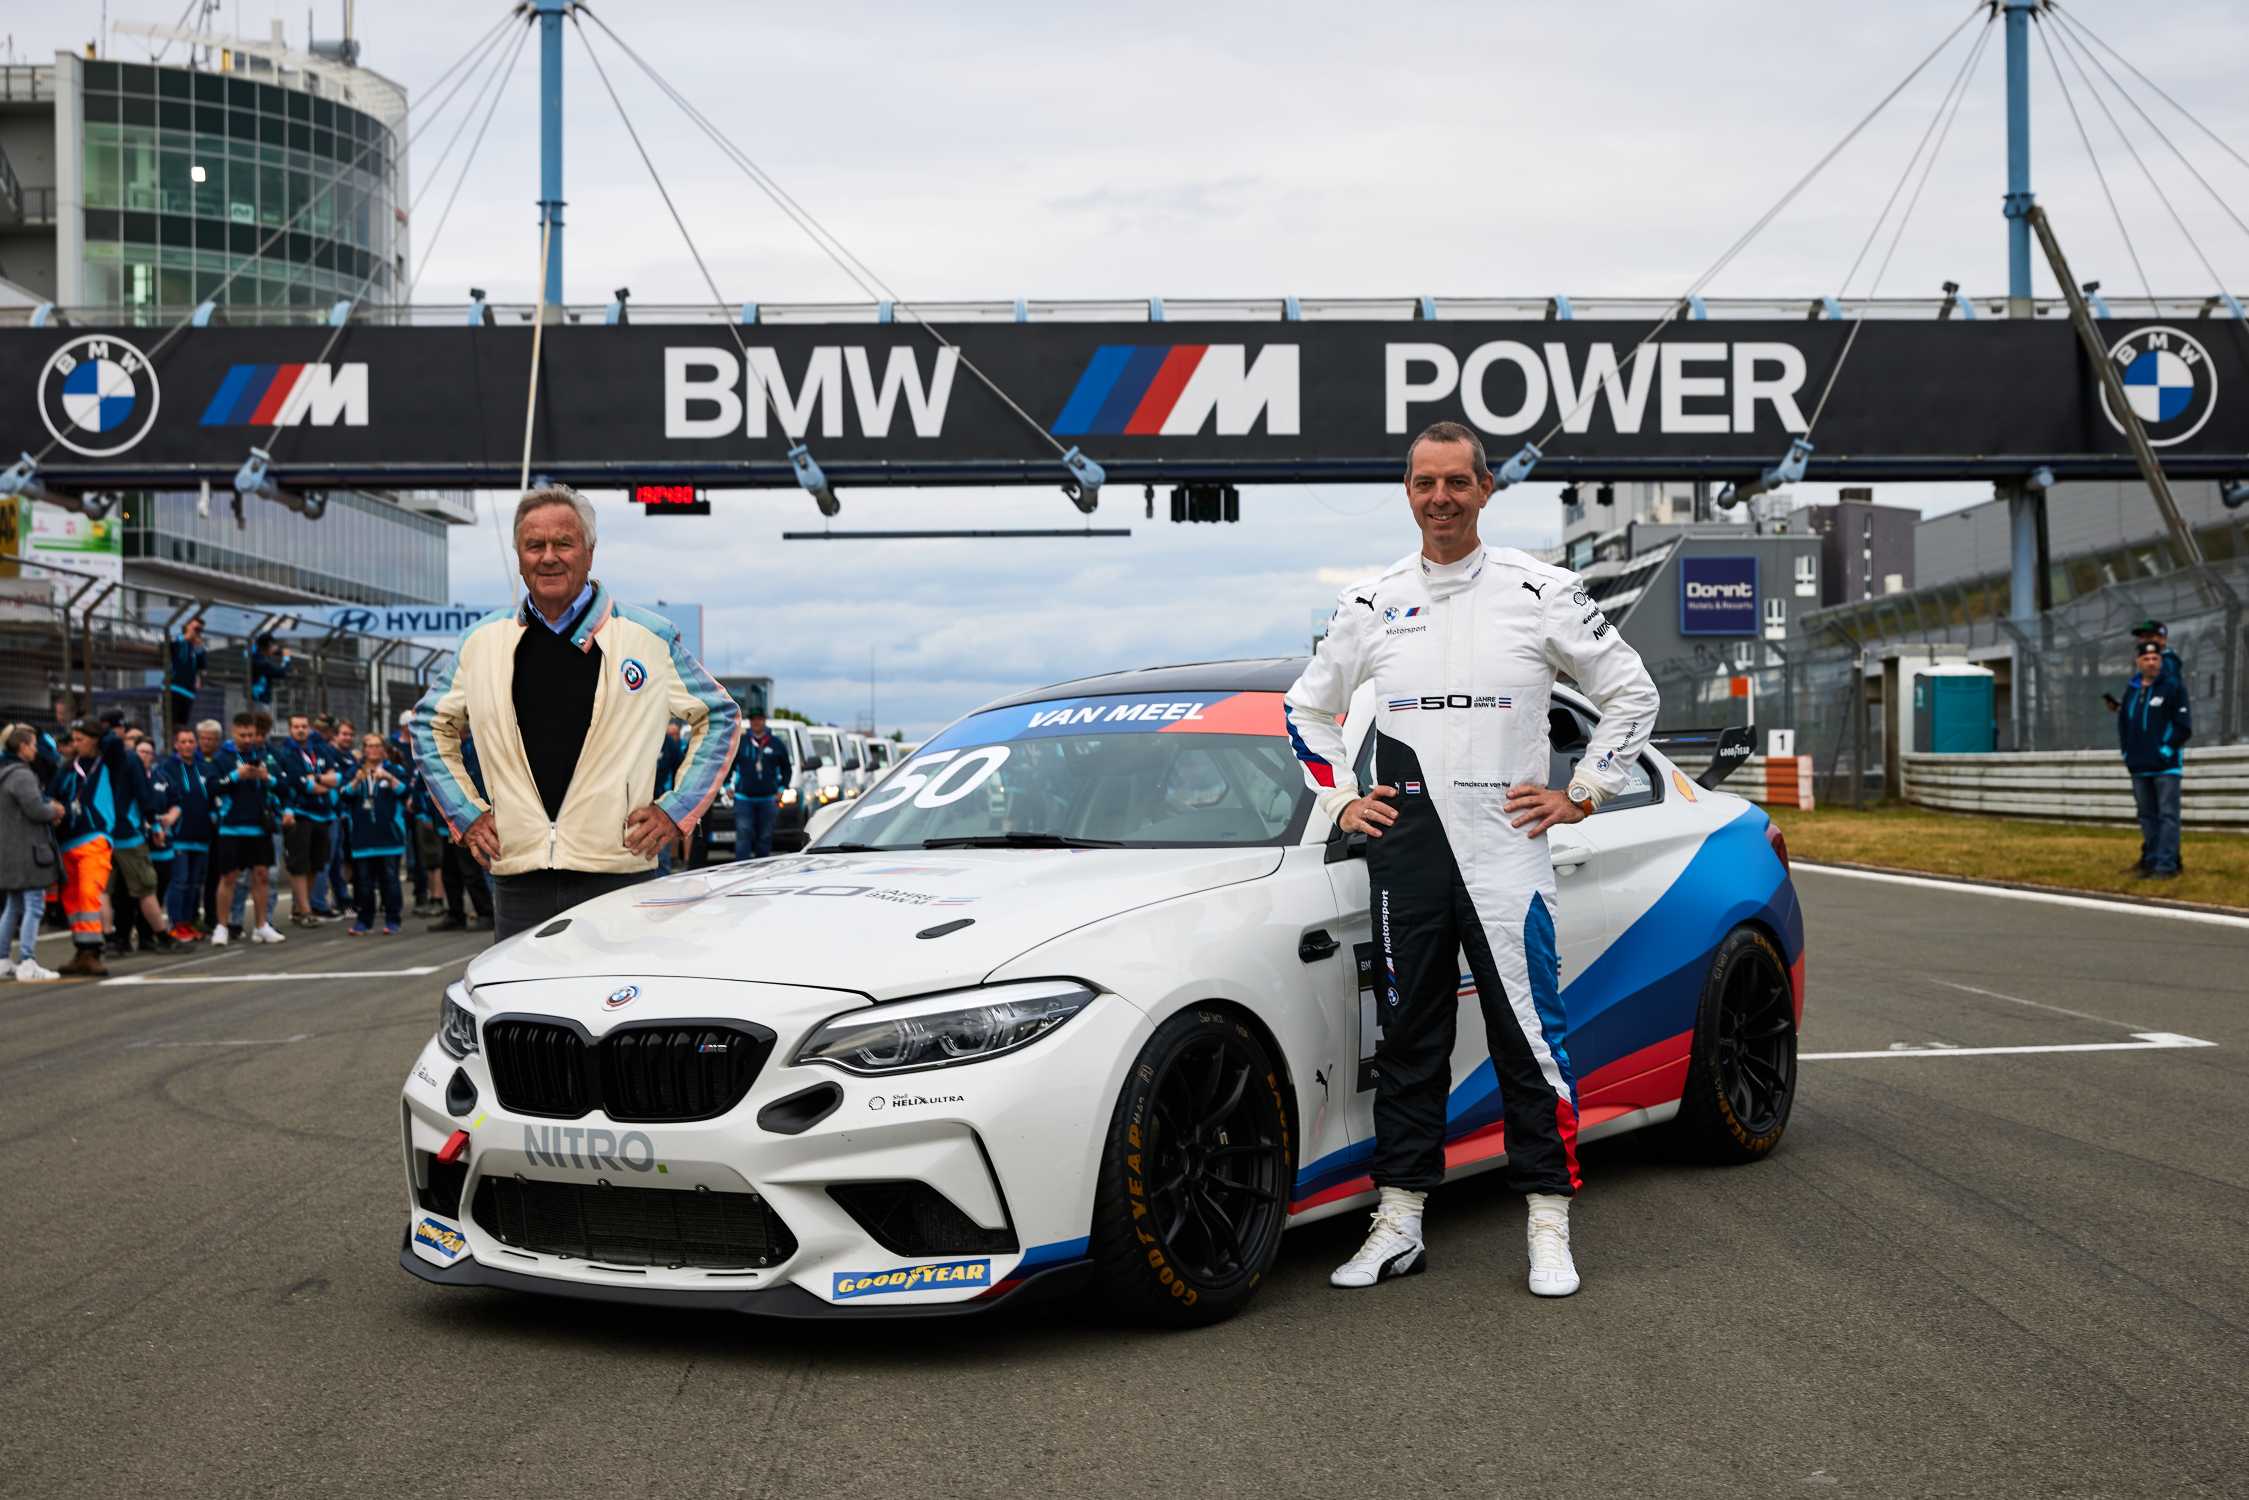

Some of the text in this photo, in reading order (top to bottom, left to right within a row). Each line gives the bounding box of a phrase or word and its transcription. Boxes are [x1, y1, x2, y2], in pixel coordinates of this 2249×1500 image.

[56, 340, 143, 376] BMW
[2115, 332, 2202, 367] BMW
[664, 345, 960, 438] BMW
[1385, 340, 1810, 436] POWER
[1686, 582, 1753, 598] Dorint
[1386, 625, 1427, 636] Motorsport
[1028, 702, 1205, 728] VAN MEEL
[1420, 694, 1472, 710] 50
[1777, 734, 1785, 751] 1
[853, 745, 1011, 821] 50
[725, 885, 875, 898] 50
[1382, 889, 1392, 954] Motorsport
[892, 1095, 965, 1108] HELIX ULTRA
[837, 1263, 985, 1294] GOODYEAR
